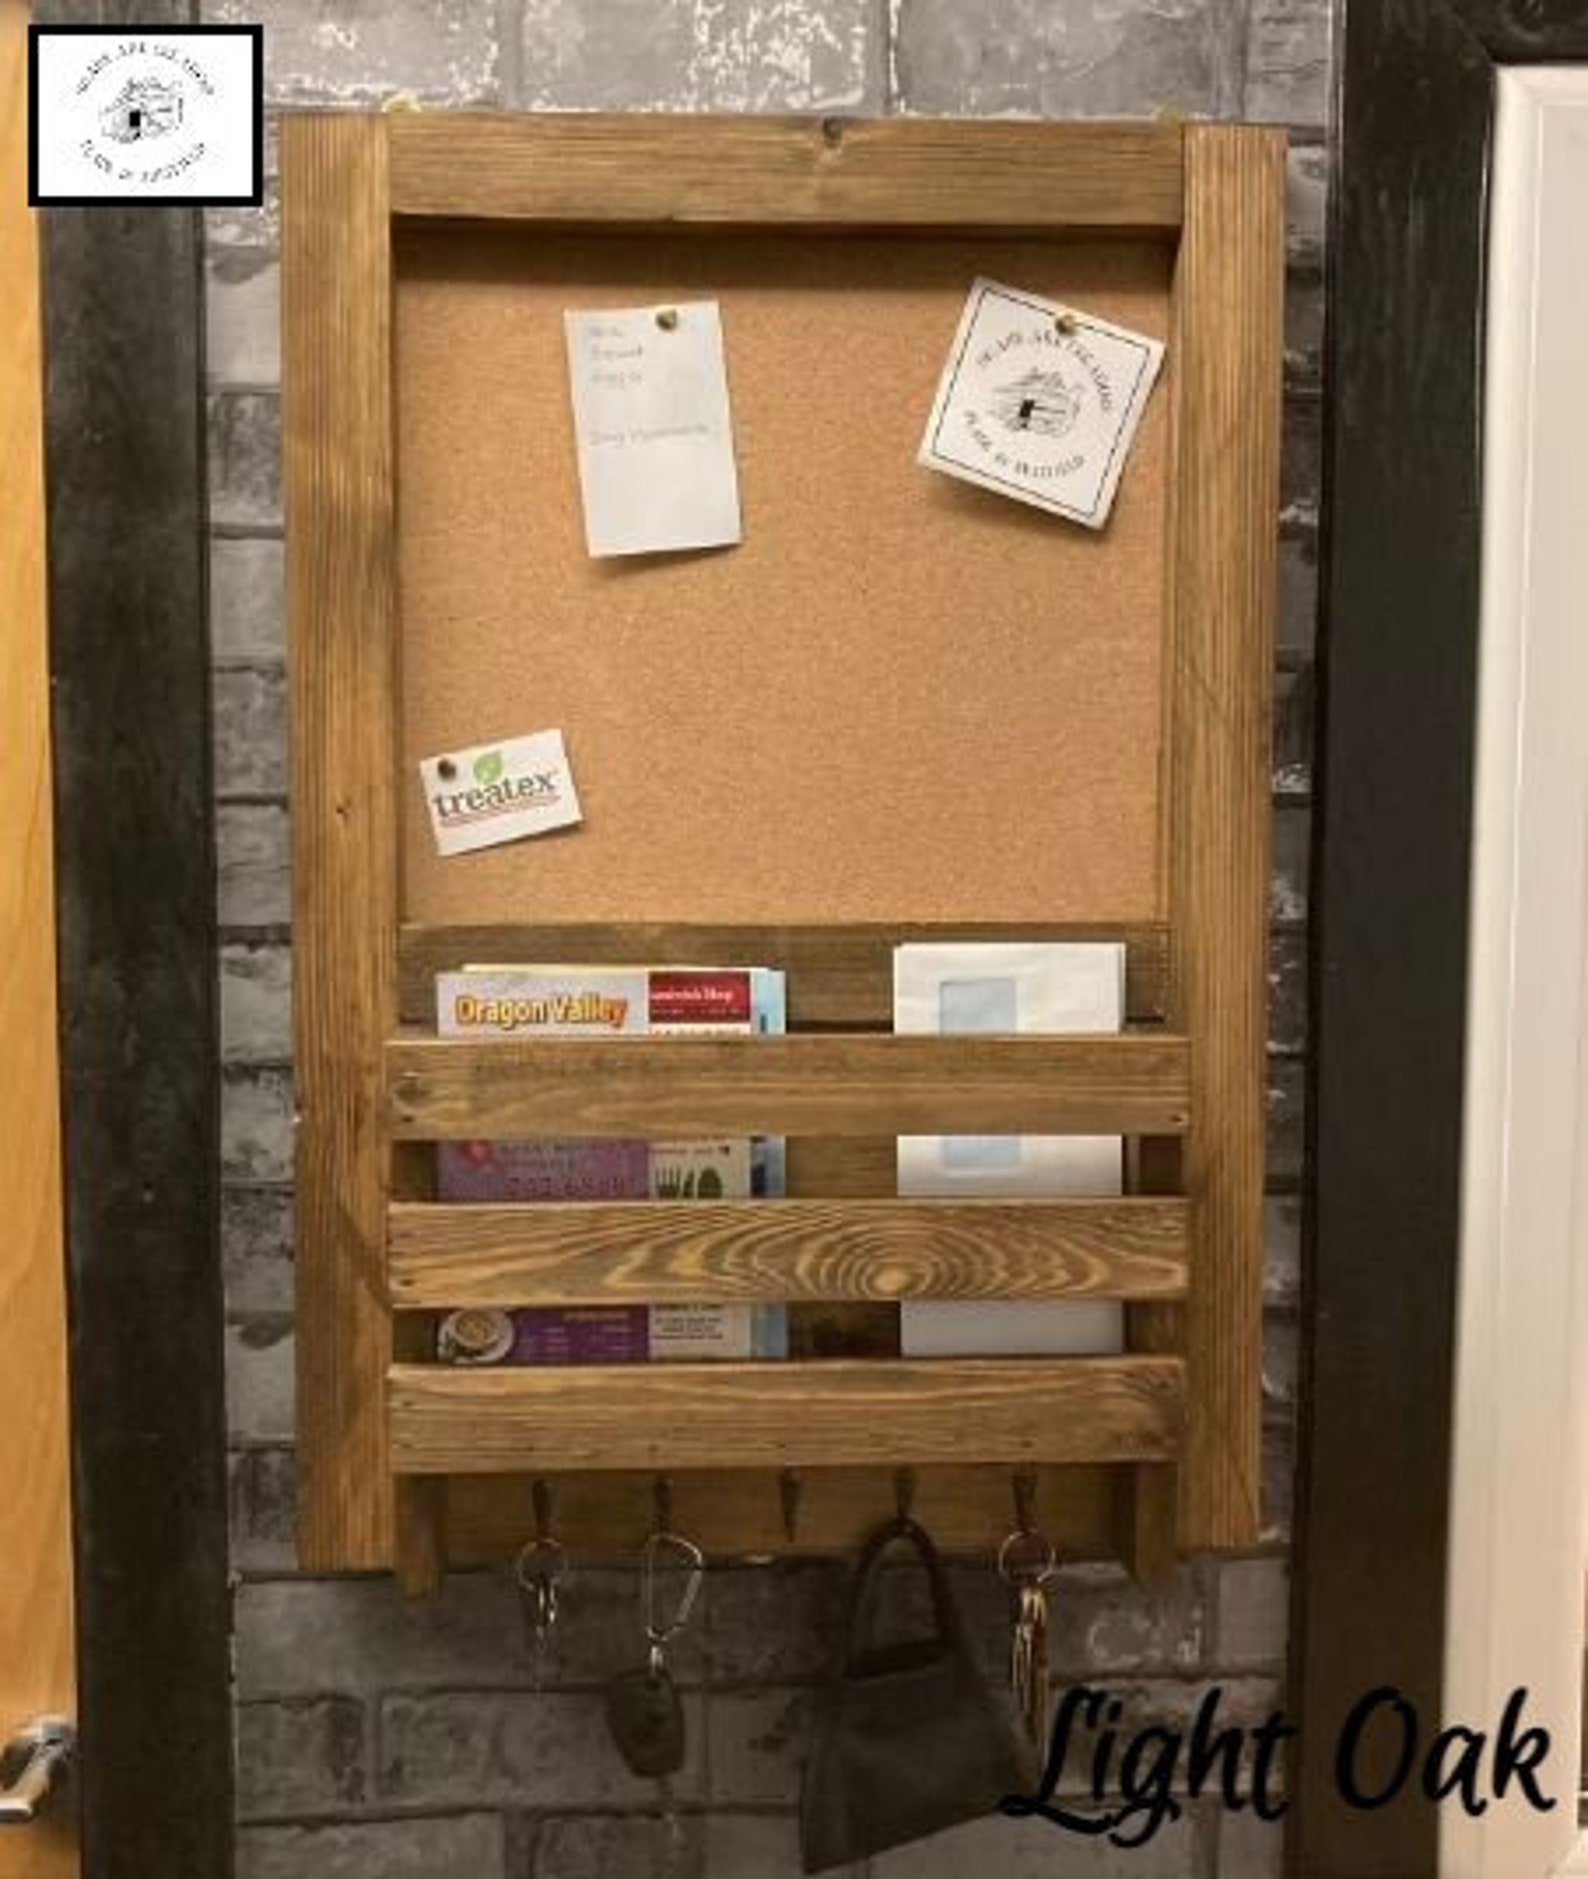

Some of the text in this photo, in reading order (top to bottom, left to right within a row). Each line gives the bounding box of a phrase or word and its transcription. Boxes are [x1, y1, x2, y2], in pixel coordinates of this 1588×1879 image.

[432, 773, 556, 818] treatex
[456, 992, 628, 1030] Dragon Valley
